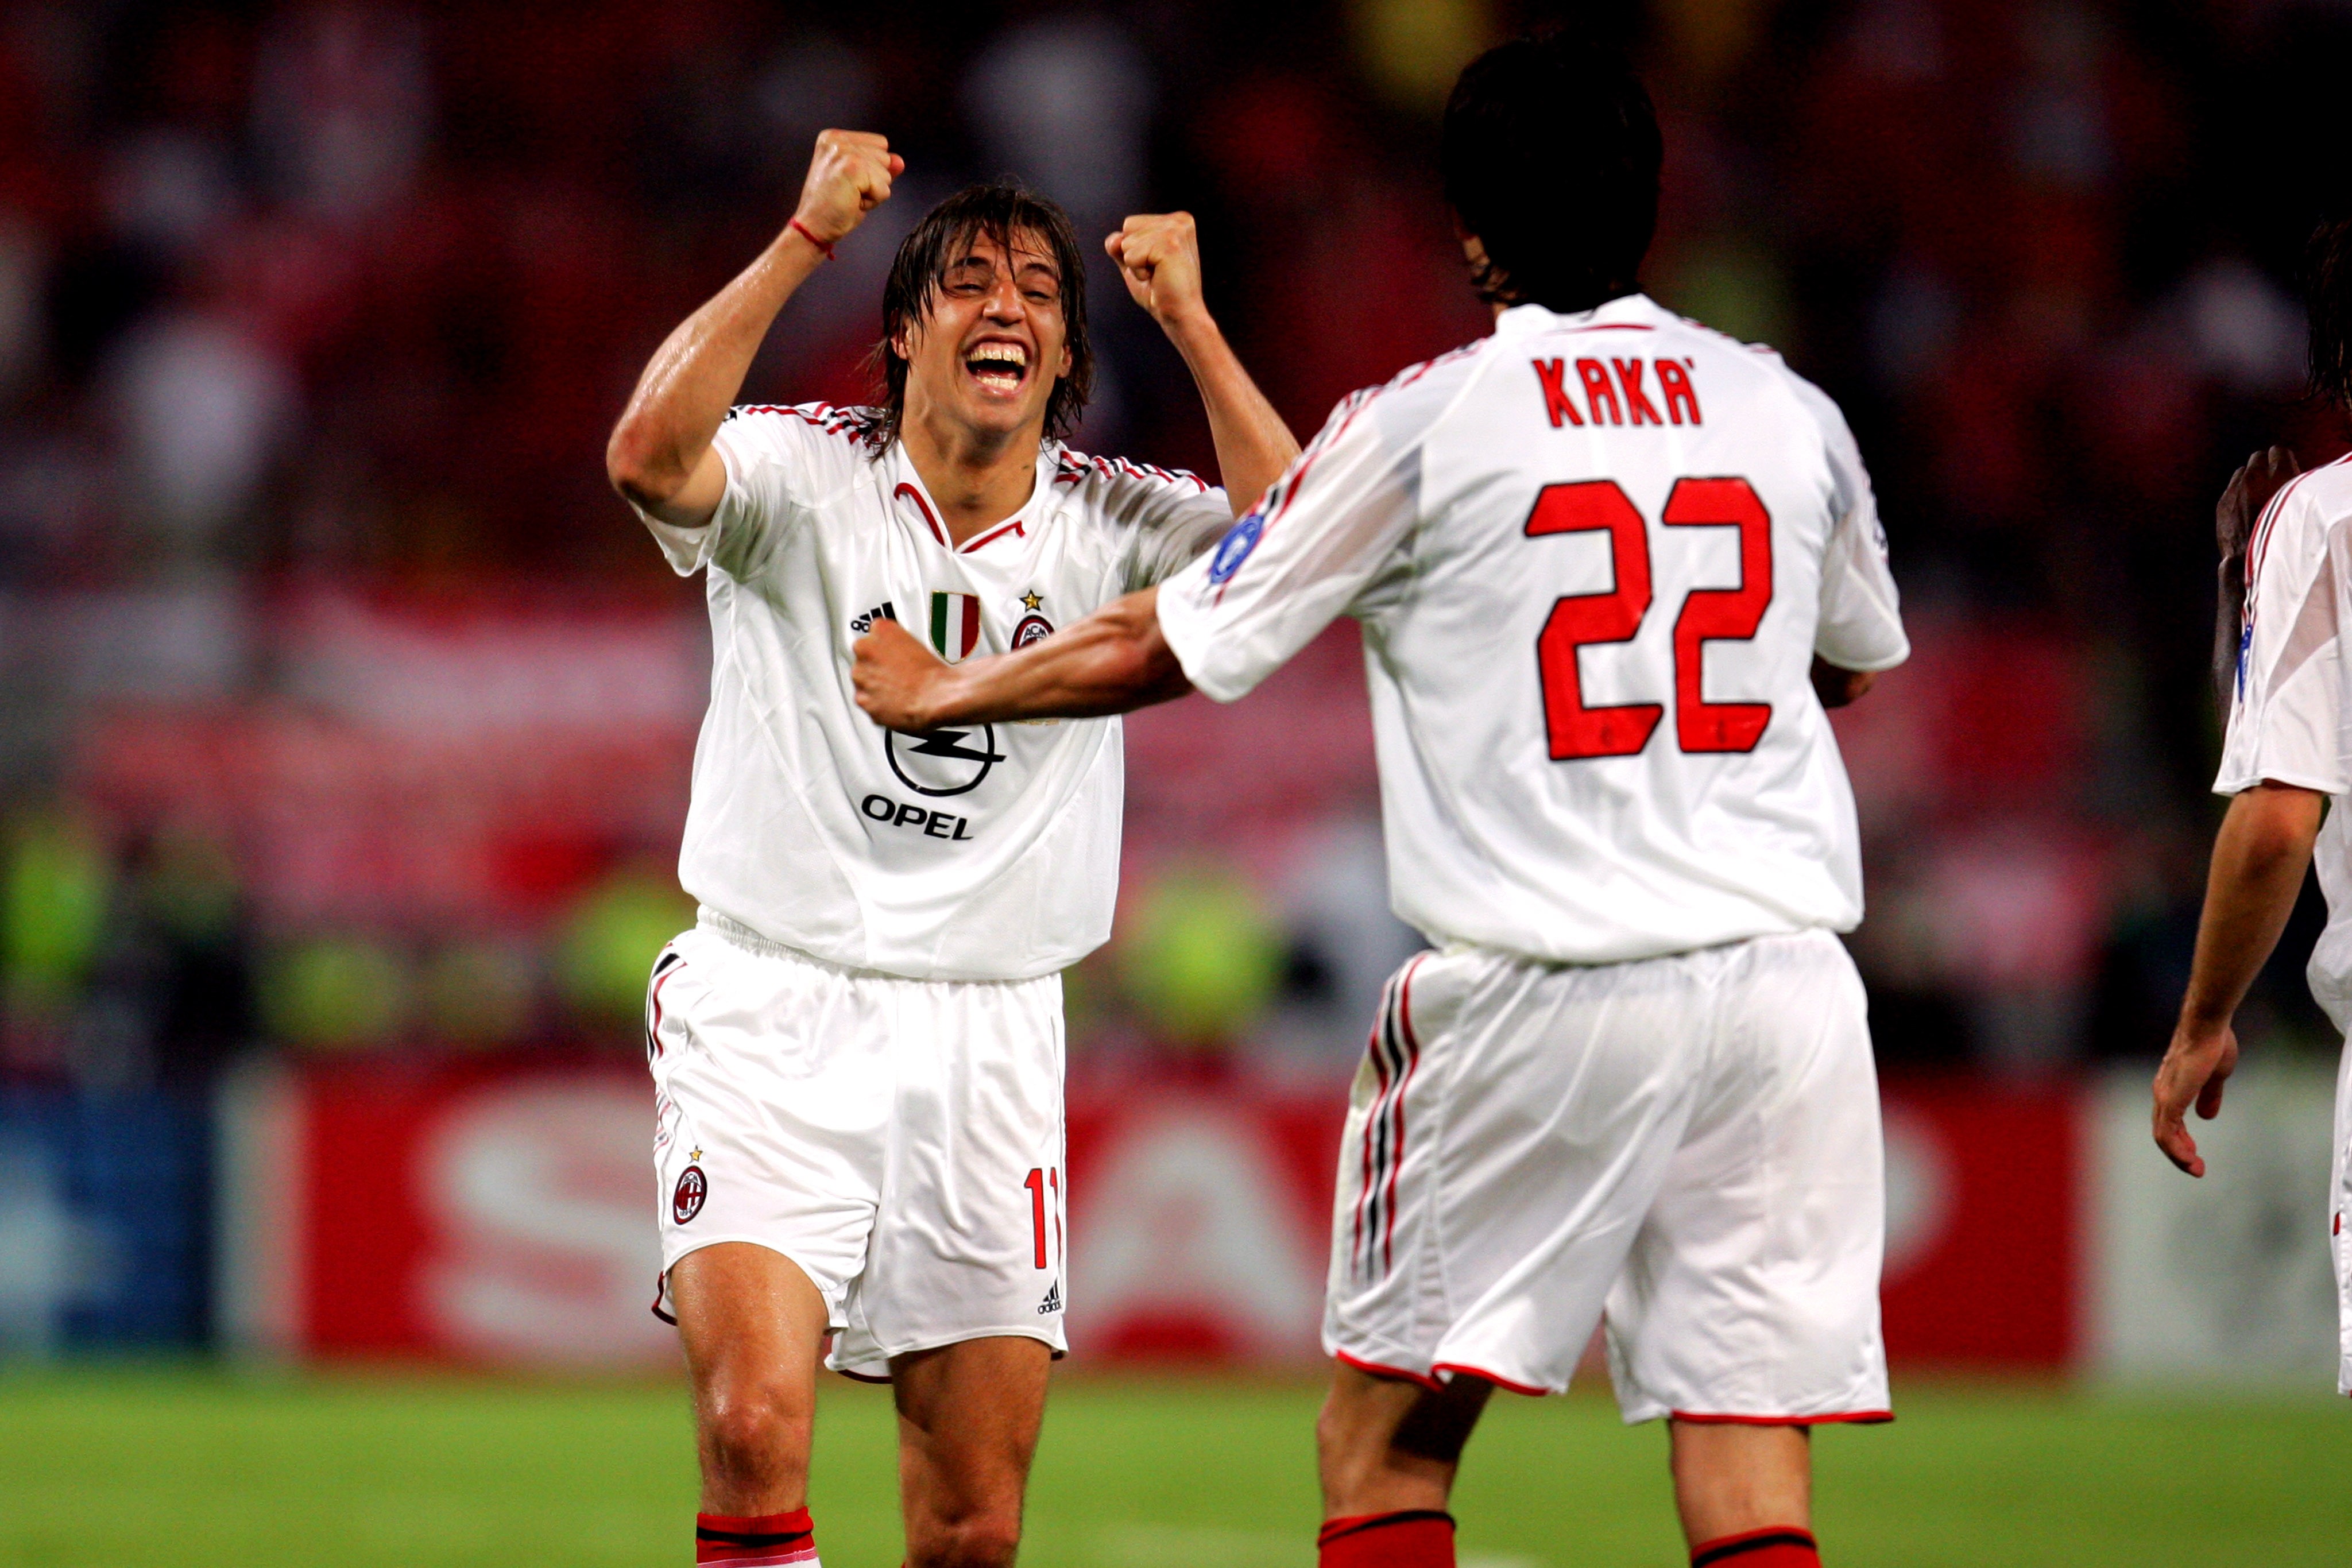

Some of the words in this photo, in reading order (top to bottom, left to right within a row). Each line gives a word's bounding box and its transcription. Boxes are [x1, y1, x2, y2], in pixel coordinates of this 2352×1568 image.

[1524, 478, 1773, 761] 22
[861, 794, 973, 841] OPEL
[1038, 1299, 1061, 1315] adida
